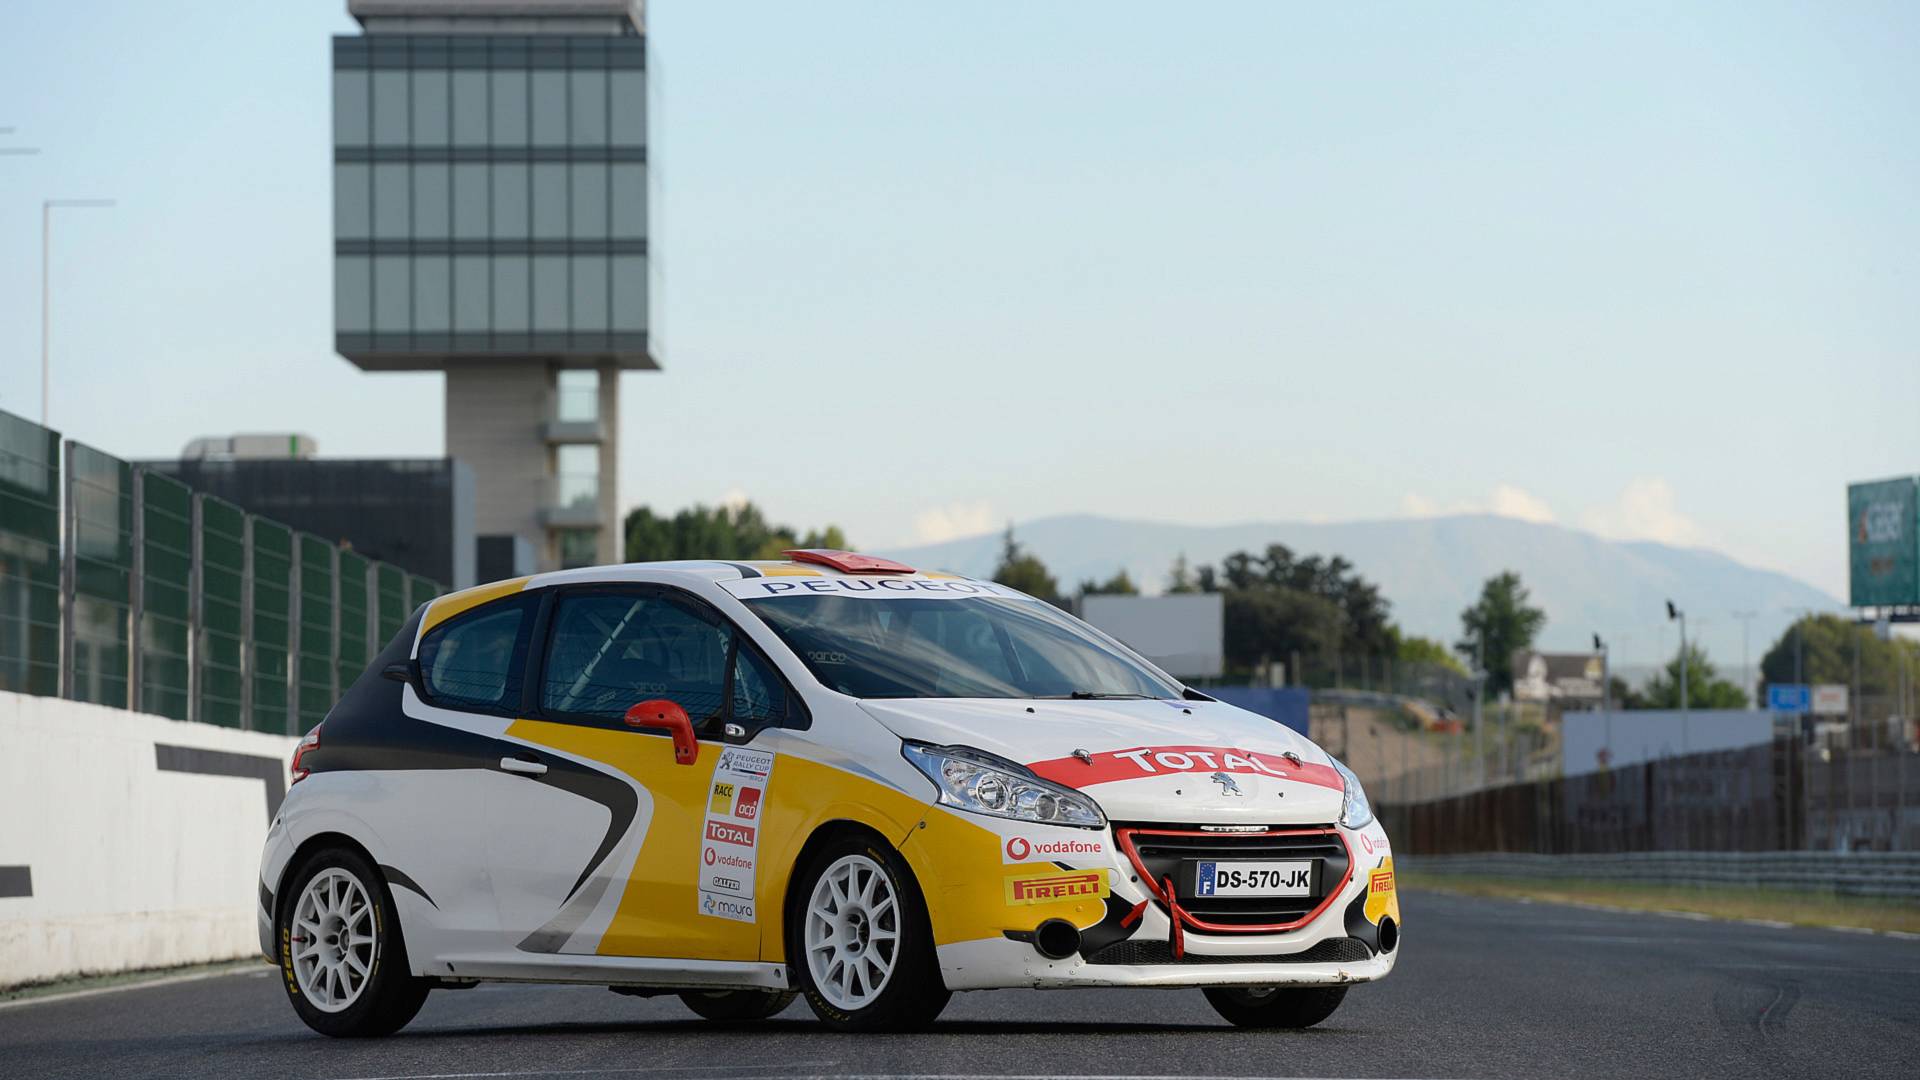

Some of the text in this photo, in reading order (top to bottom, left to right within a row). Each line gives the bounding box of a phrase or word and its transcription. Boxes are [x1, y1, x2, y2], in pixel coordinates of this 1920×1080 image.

[761, 577, 1001, 595] PEUGEOT
[733, 760, 770, 772] RALLY CUP
[736, 754, 771, 765] PEUGEOT
[1113, 748, 1288, 776] TOTAL
[714, 784, 732, 797] RACC
[709, 823, 752, 844] TOTAL
[1034, 840, 1102, 855] vodafone
[717, 855, 752, 870] vodafone
[1013, 874, 1100, 900] PIRELLI
[1203, 870, 1310, 895] F DS-570-JK
[718, 901, 753, 917] moura
